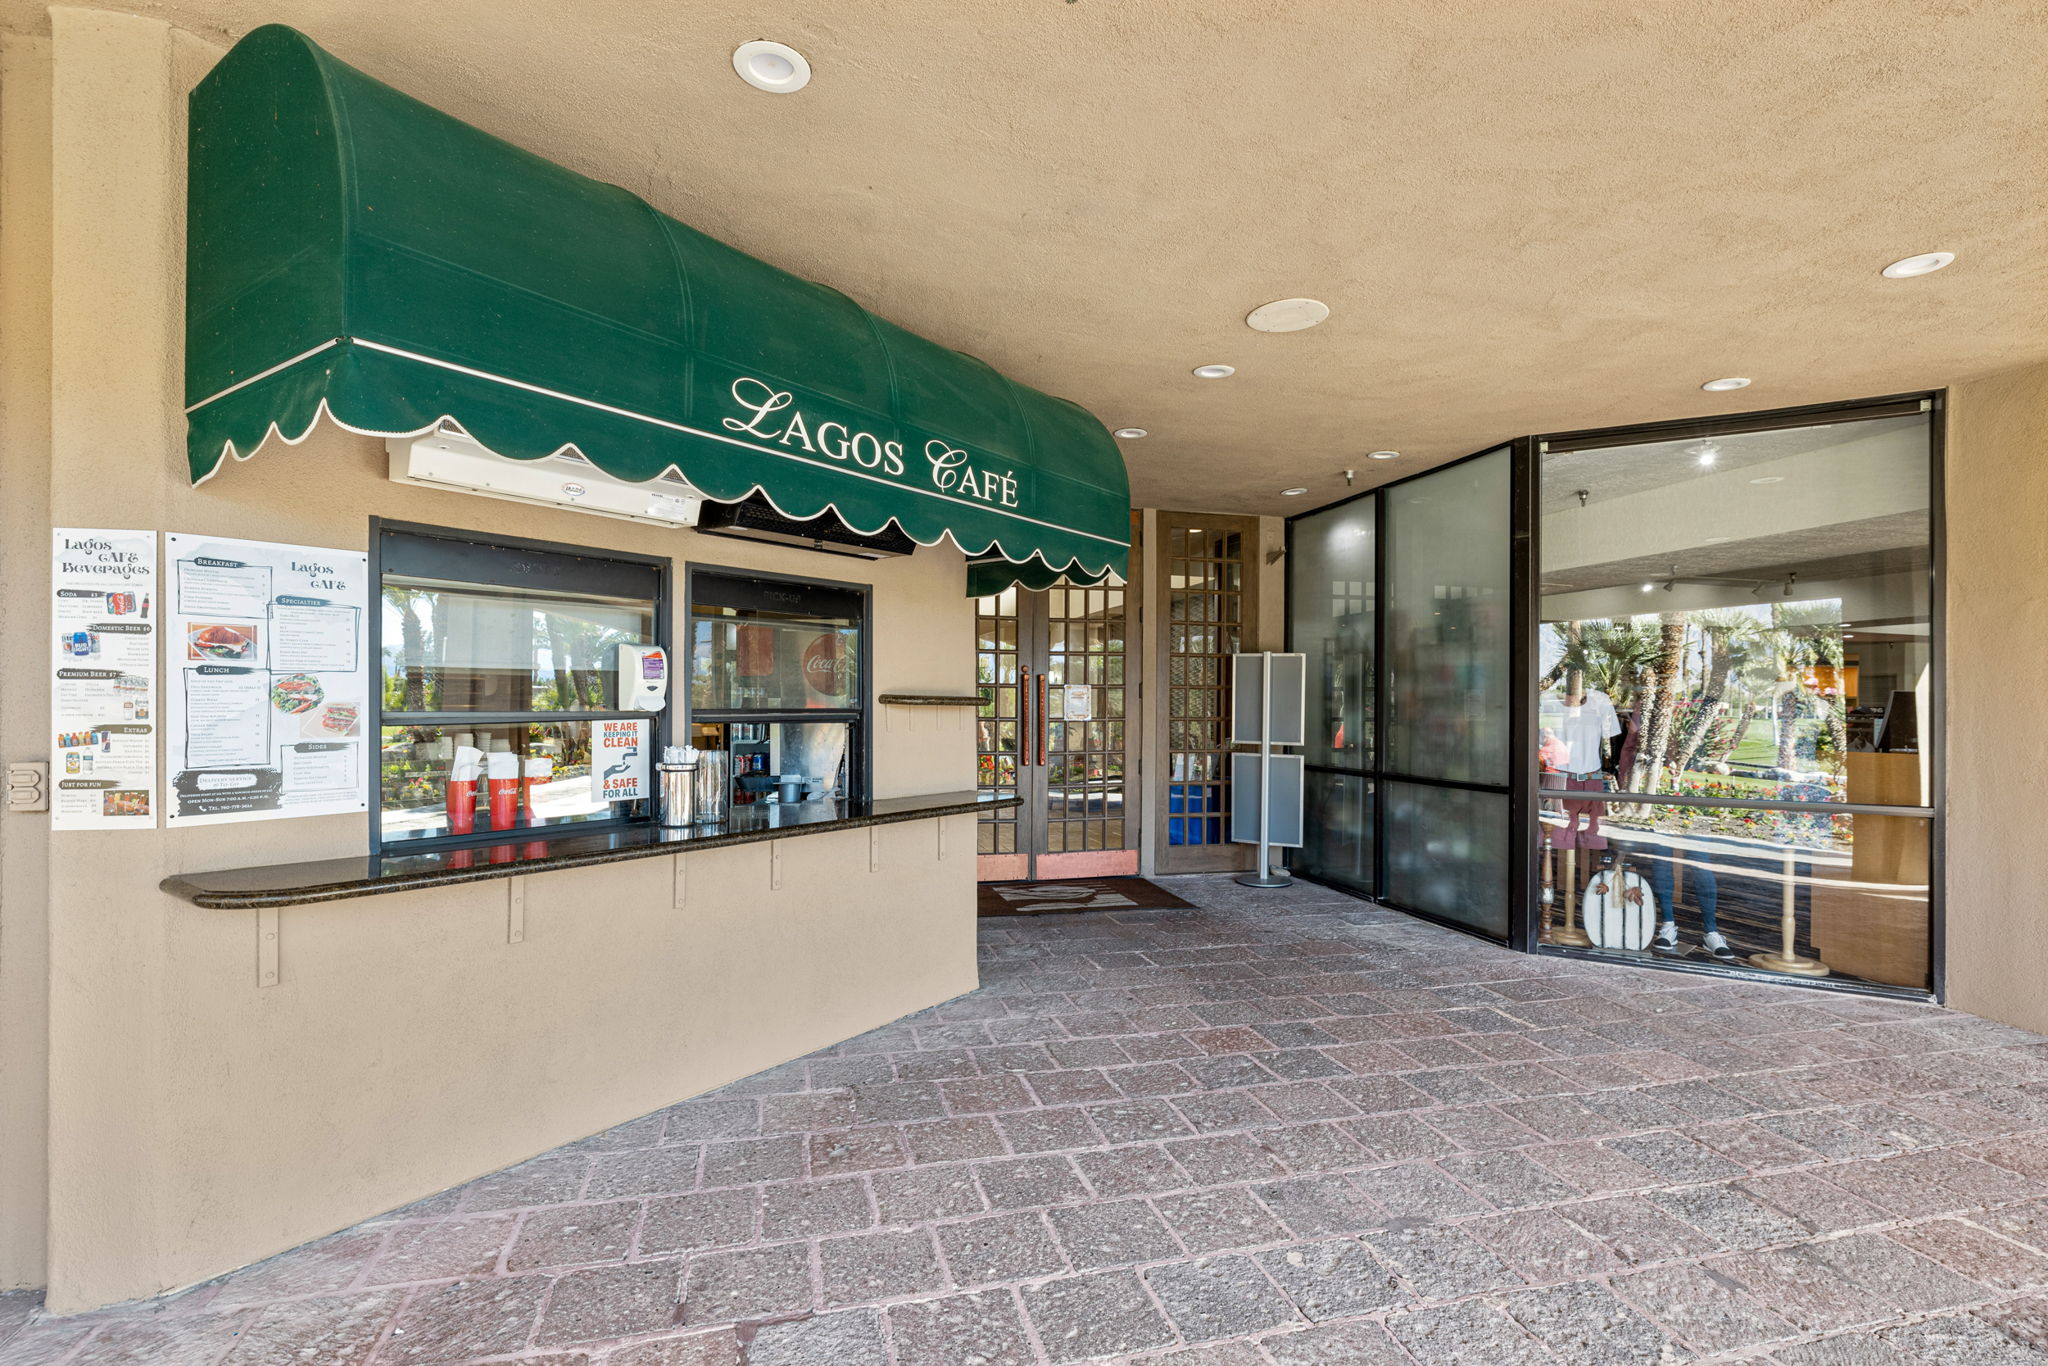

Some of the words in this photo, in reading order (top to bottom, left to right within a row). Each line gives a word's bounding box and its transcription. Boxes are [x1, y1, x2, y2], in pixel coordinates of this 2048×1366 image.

[722, 377, 904, 475] LAGOS
[925, 439, 1018, 507] CAFÉ
[65, 538, 112, 555] Lagos
[62, 562, 150, 580] Beverages
[291, 561, 334, 578] Lagos
[92, 624, 124, 632] DOMESTIC
[59, 670, 89, 678] PREMIUM
[203, 666, 230, 674] LUNCH
[603, 722, 618, 732] WE
[620, 722, 638, 731] ARE
[603, 737, 639, 748] CLEAN
[603, 779, 610, 789] &
[612, 778, 638, 788] SAFE
[603, 789, 620, 799] FOR
[622, 787, 639, 797] ALL
